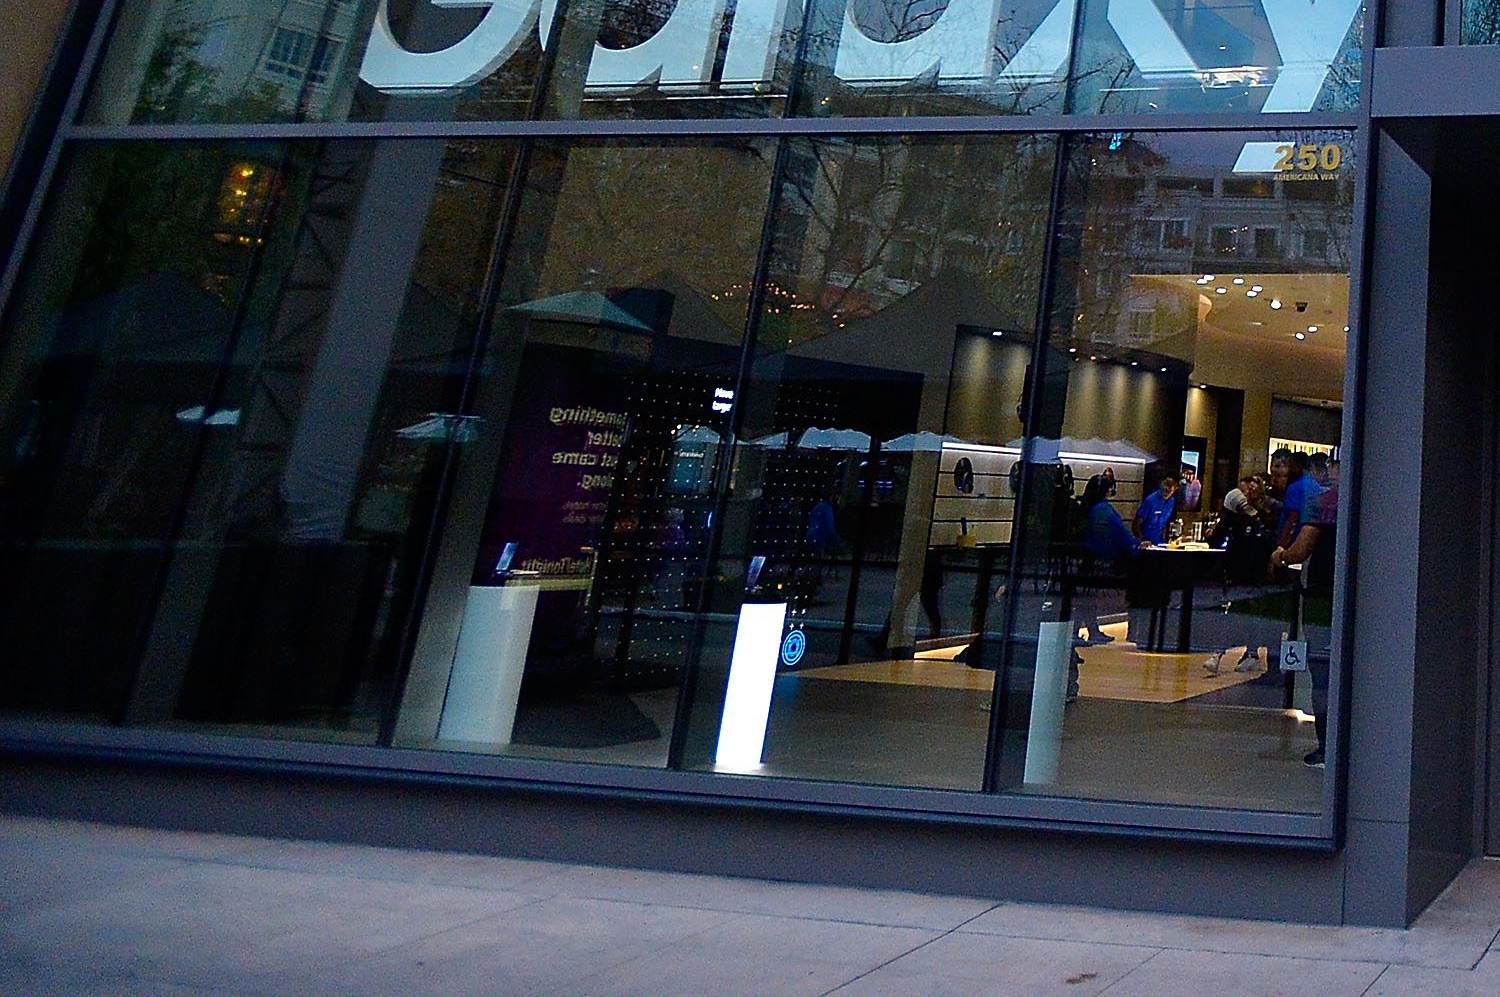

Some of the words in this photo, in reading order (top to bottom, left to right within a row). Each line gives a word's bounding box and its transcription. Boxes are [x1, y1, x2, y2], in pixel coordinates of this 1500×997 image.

[1273, 143, 1341, 171] 250
[1273, 172, 1319, 182] AMERICANA
[1320, 172, 1340, 181] WAY
